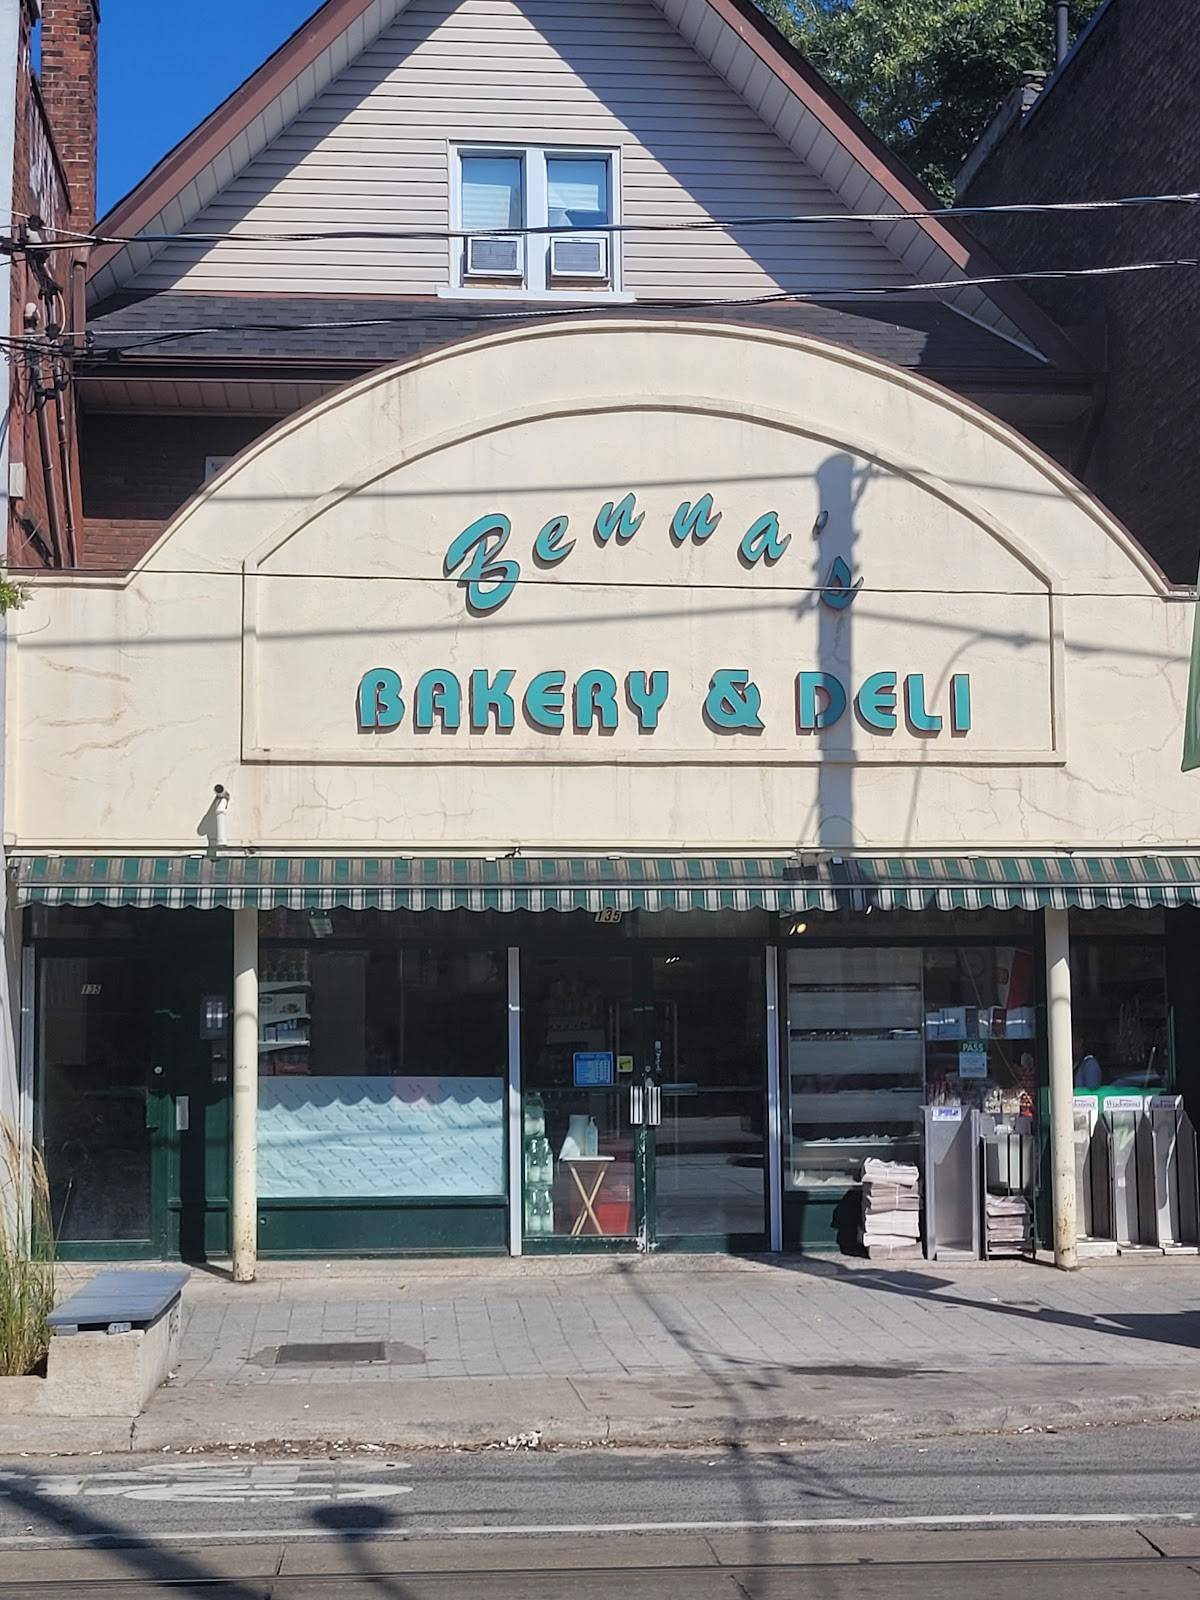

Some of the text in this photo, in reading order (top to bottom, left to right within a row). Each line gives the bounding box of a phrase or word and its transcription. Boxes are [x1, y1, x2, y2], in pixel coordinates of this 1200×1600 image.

[444, 493, 864, 613] Benna's
[357, 668, 971, 735] BAKERY & DELI
[594, 908, 622, 922] 135
[962, 1042, 984, 1052] PASS
